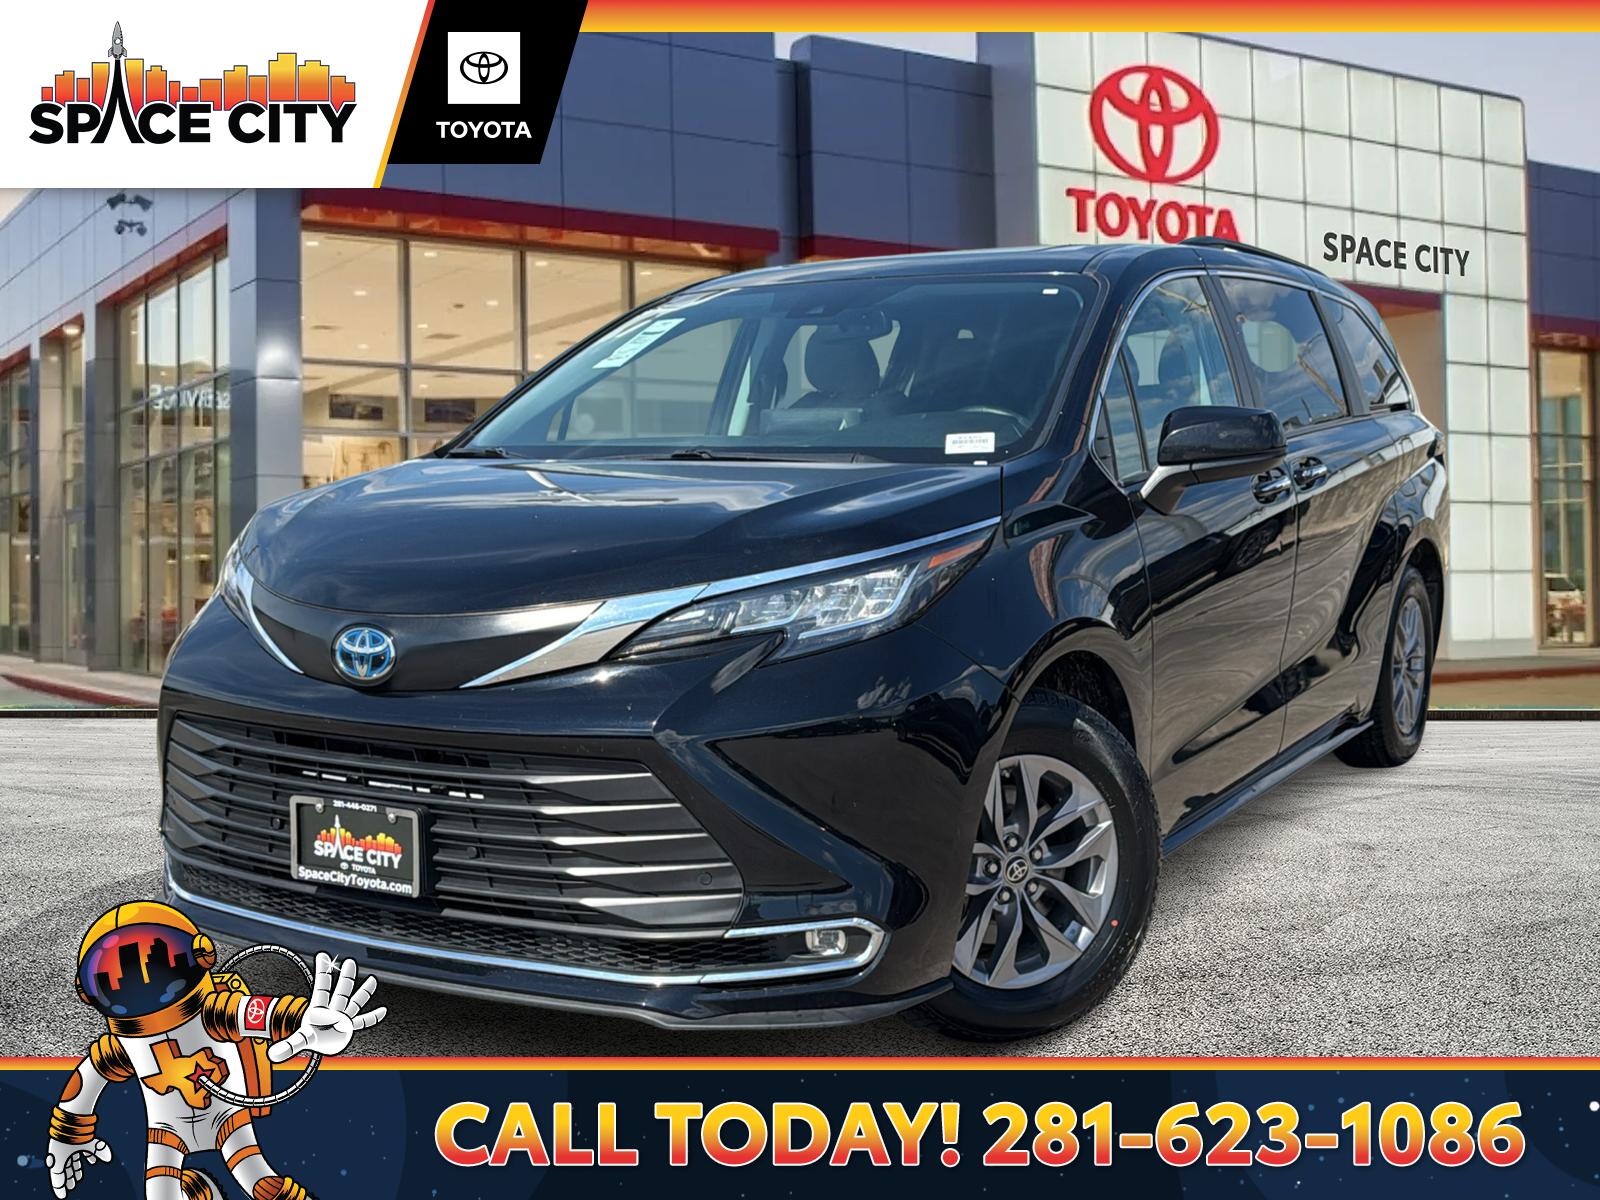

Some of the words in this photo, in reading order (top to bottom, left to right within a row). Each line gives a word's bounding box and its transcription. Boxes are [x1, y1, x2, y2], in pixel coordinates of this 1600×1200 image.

[1066, 187, 1242, 244] TOYOTA
[1323, 231, 1407, 270] SPACE
[1414, 244, 1471, 277] CITY
[313, 839, 364, 861] SPACE
[366, 848, 403, 869] CITY
[351, 863, 377, 875] TOYOTA
[298, 865, 413, 895] SpaceCityToyota.com
